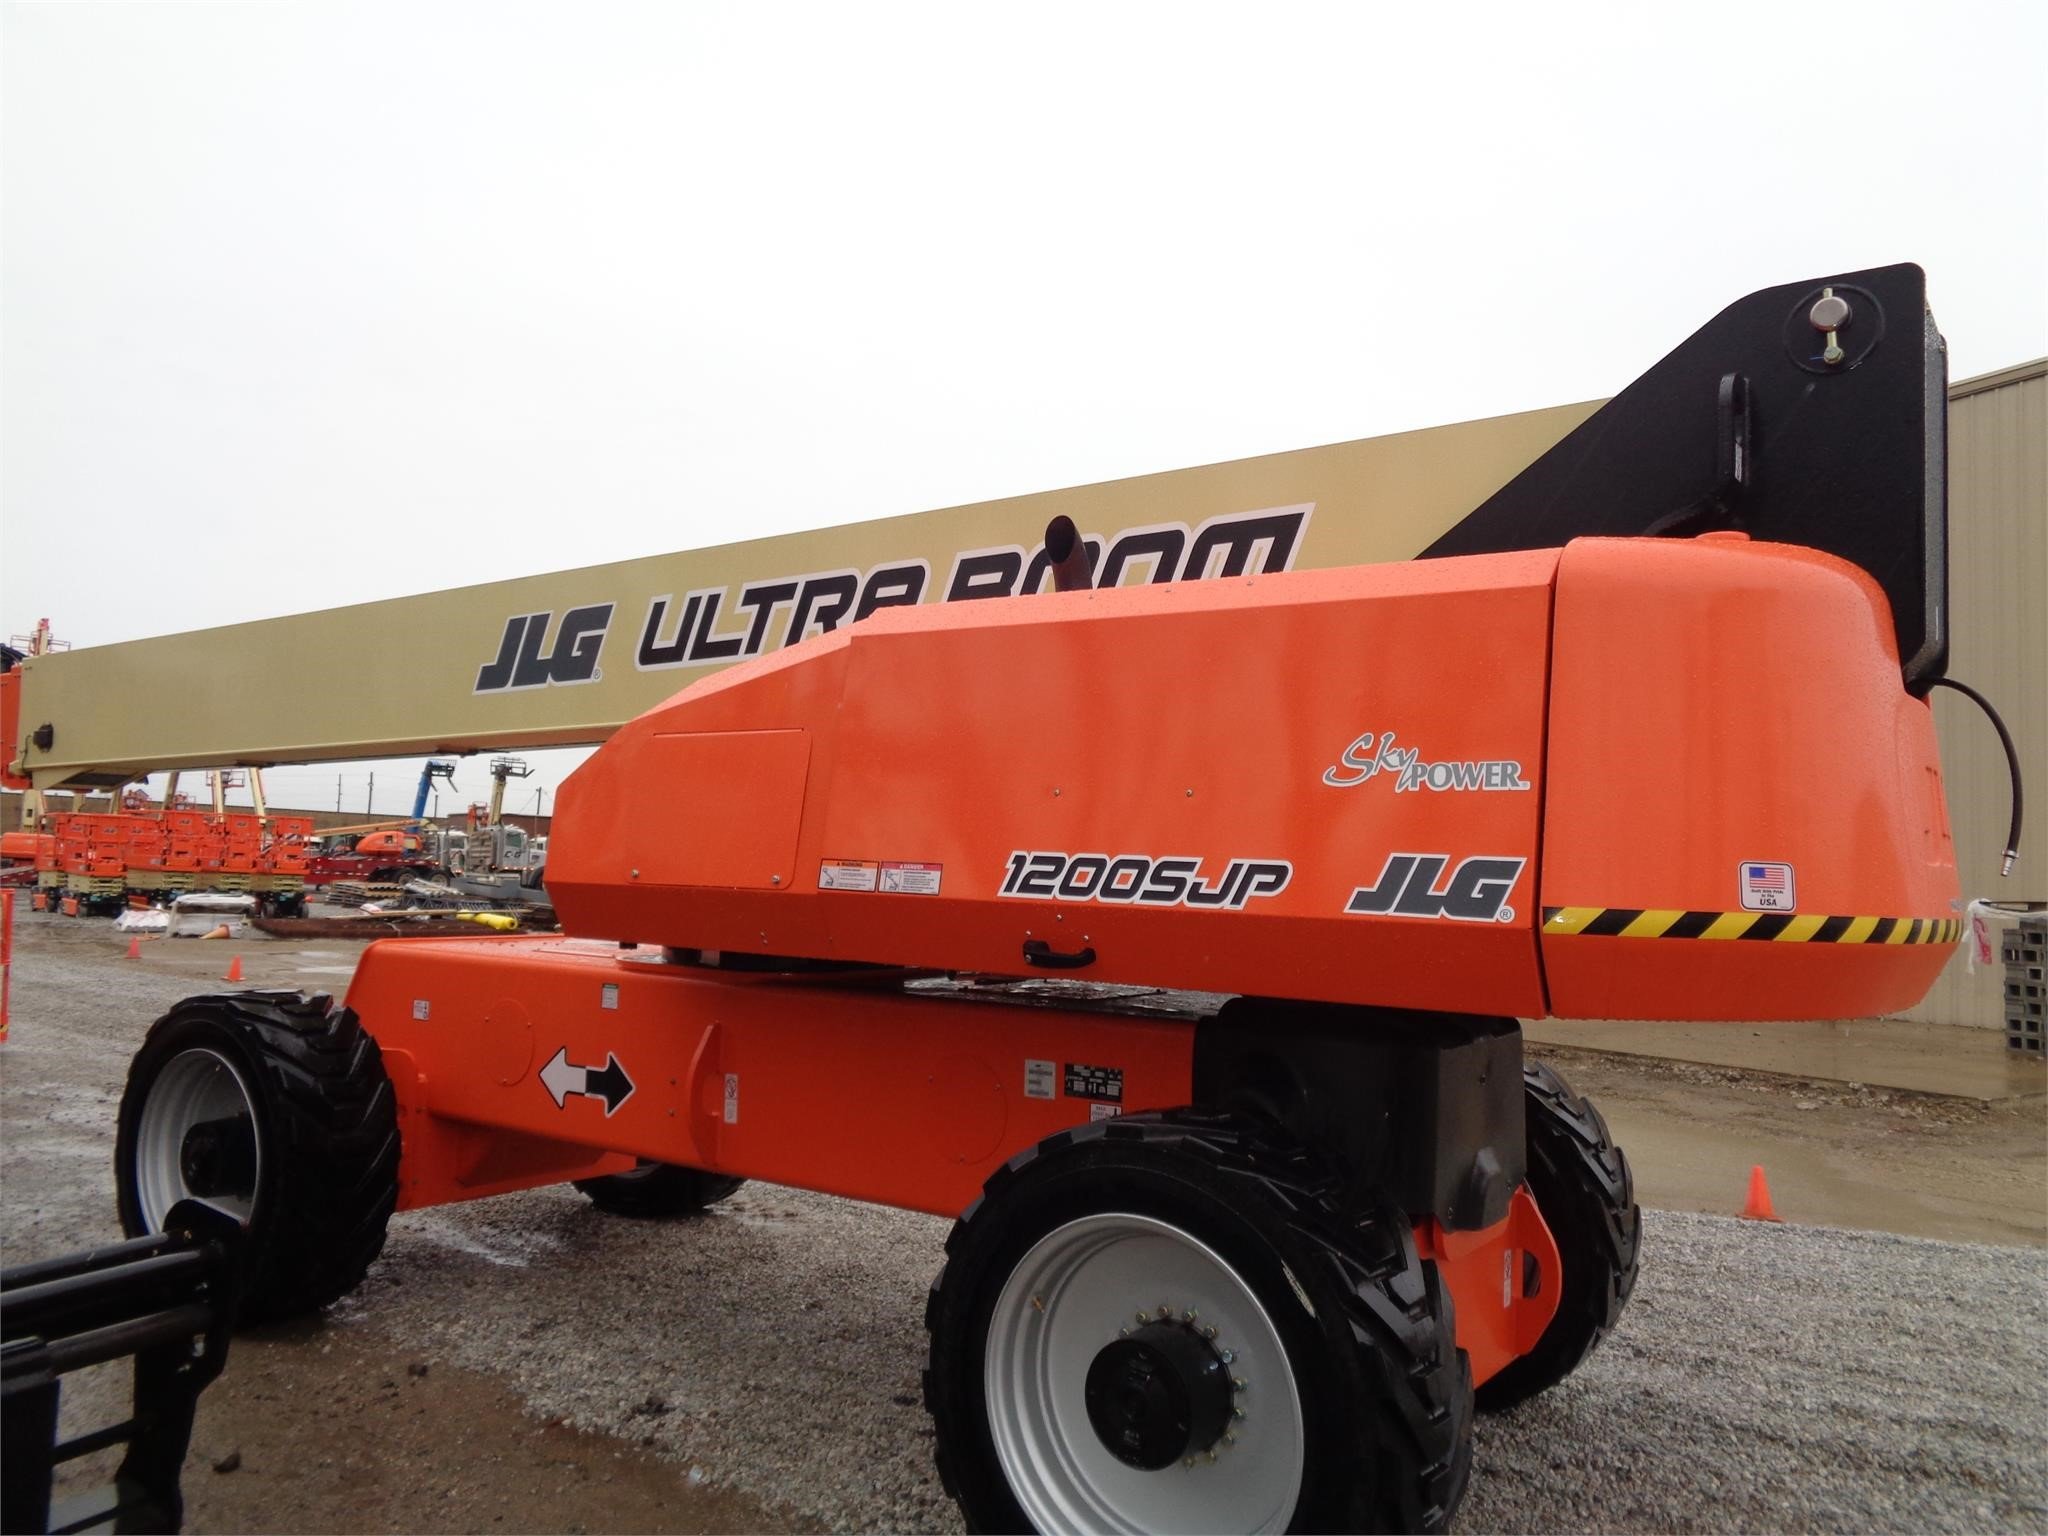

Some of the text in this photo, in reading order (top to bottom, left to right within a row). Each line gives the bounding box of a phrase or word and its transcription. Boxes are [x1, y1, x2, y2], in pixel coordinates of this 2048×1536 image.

[474, 602, 615, 693] JLG
[636, 560, 930, 668] ULTRA
[999, 852, 1293, 909] 1200SJP
[1346, 853, 1526, 921] JLG
[1760, 898, 1777, 906] USA
